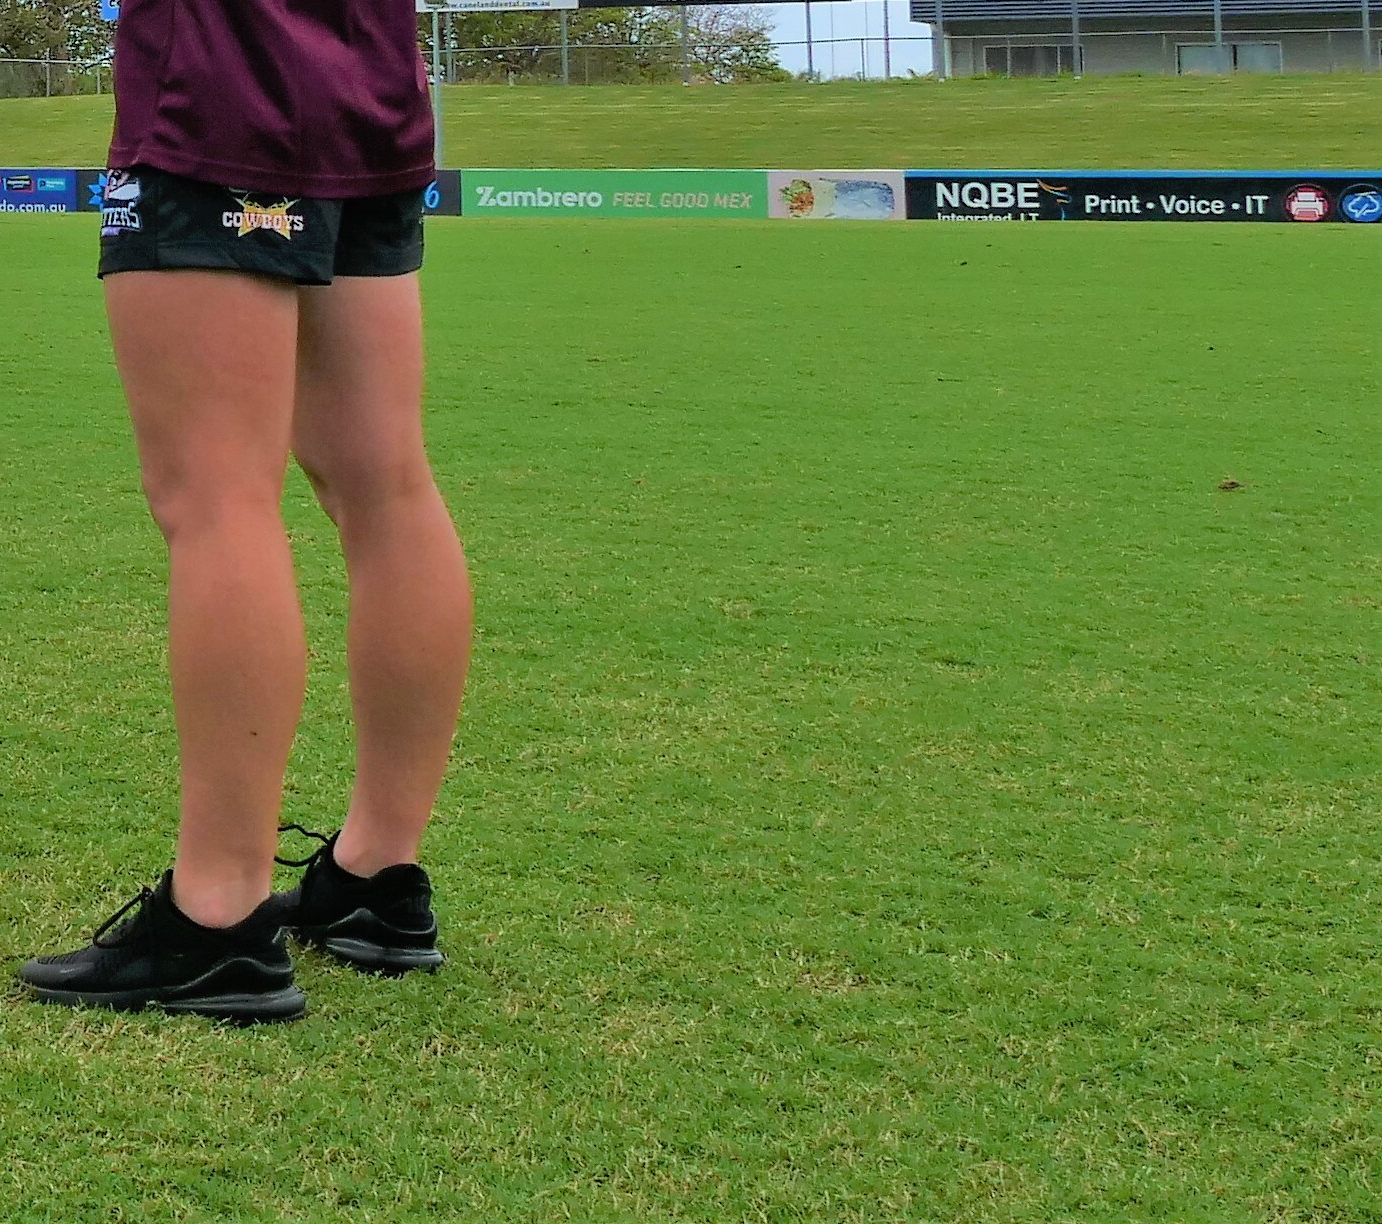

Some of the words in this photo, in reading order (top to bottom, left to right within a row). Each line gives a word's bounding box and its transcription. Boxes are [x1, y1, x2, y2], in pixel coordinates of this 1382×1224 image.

[476, 186, 602, 207] Zambrero
[612, 192, 656, 208] FEEL
[659, 192, 708, 208] GOOD
[714, 192, 753, 209] MEX
[936, 182, 1040, 209] NQBE
[1085, 194, 1140, 214] Print
[1159, 194, 1225, 215] Voice
[1245, 194, 1270, 215] IT
[222, 211, 304, 231] COWBOYS
